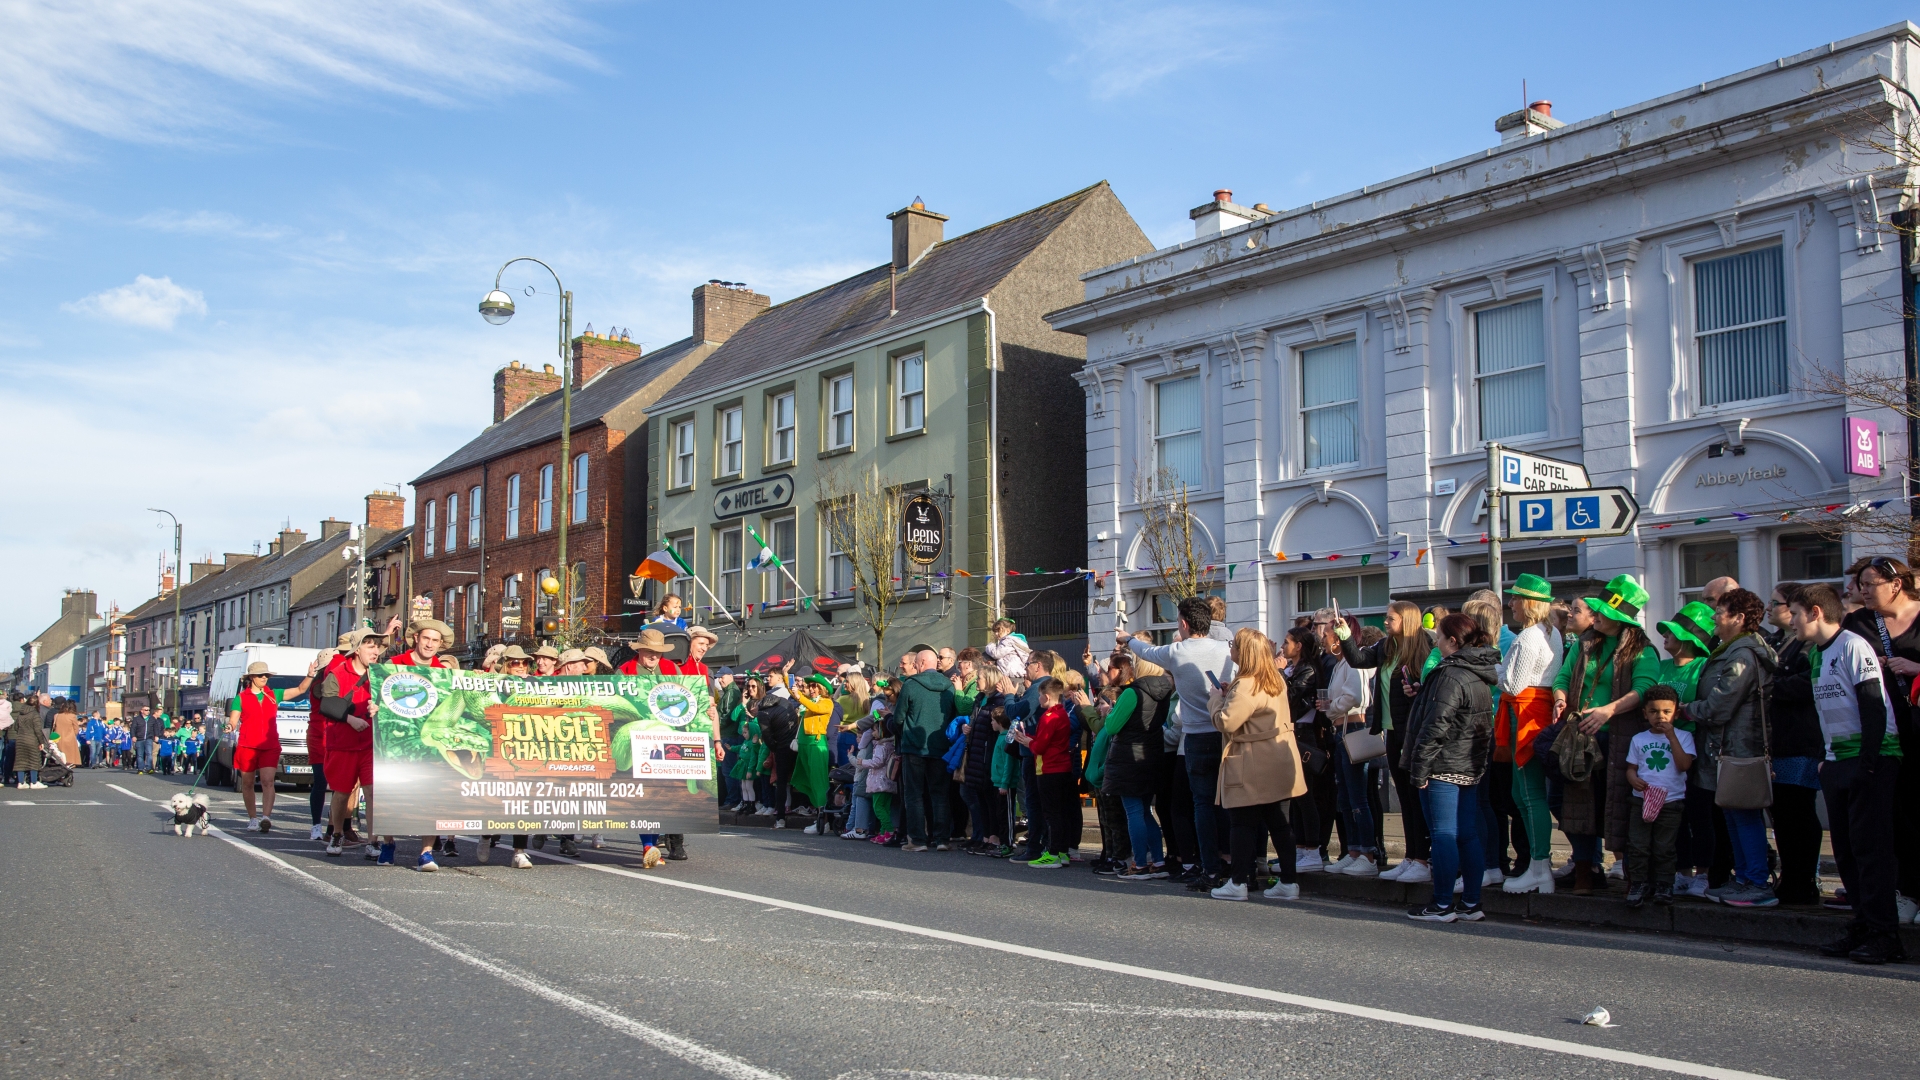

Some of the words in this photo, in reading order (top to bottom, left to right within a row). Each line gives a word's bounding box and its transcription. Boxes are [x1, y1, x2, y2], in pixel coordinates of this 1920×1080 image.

[1857, 453, 1874, 469] AIB
[1506, 459, 1519, 482] P
[1533, 461, 1569, 481] HOTEL
[1695, 464, 1787, 488] Abbeyfeale
[1524, 476, 1546, 492] CAR
[734, 487, 769, 509] HOTEL
[1526, 503, 1545, 528] P
[907, 521, 940, 545] Leens
[913, 544, 934, 553] HOTEL
[451, 675, 557, 696] ABBEYFEALE
[557, 681, 615, 697] UNITED
[619, 681, 639, 697] FC
[1813, 683, 1842, 693] tandard
[515, 696, 548, 705] PROUDLY
[550, 697, 583, 706] PRESENT
[499, 713, 604, 743] JUNGLE
[501, 741, 608, 762] CHALLENGE
[1641, 740, 1672, 754] IRELAN
[548, 763, 596, 772] FUNDRAISER
[460, 781, 532, 797] SATURDAY
[536, 782, 566, 797] 27TH
[569, 782, 607, 797] APRIL
[610, 783, 645, 798] 2024
[502, 800, 530, 815] THE
[533, 800, 580, 815] DEVON
[583, 800, 607, 815] INN
[487, 820, 516, 830] Doors
[517, 820, 542, 831] Open
[543, 820, 575, 831] 7.00pm
[582, 820, 604, 829] Start
[604, 820, 629, 829] Time:
[630, 820, 661, 831] 8.00pm
